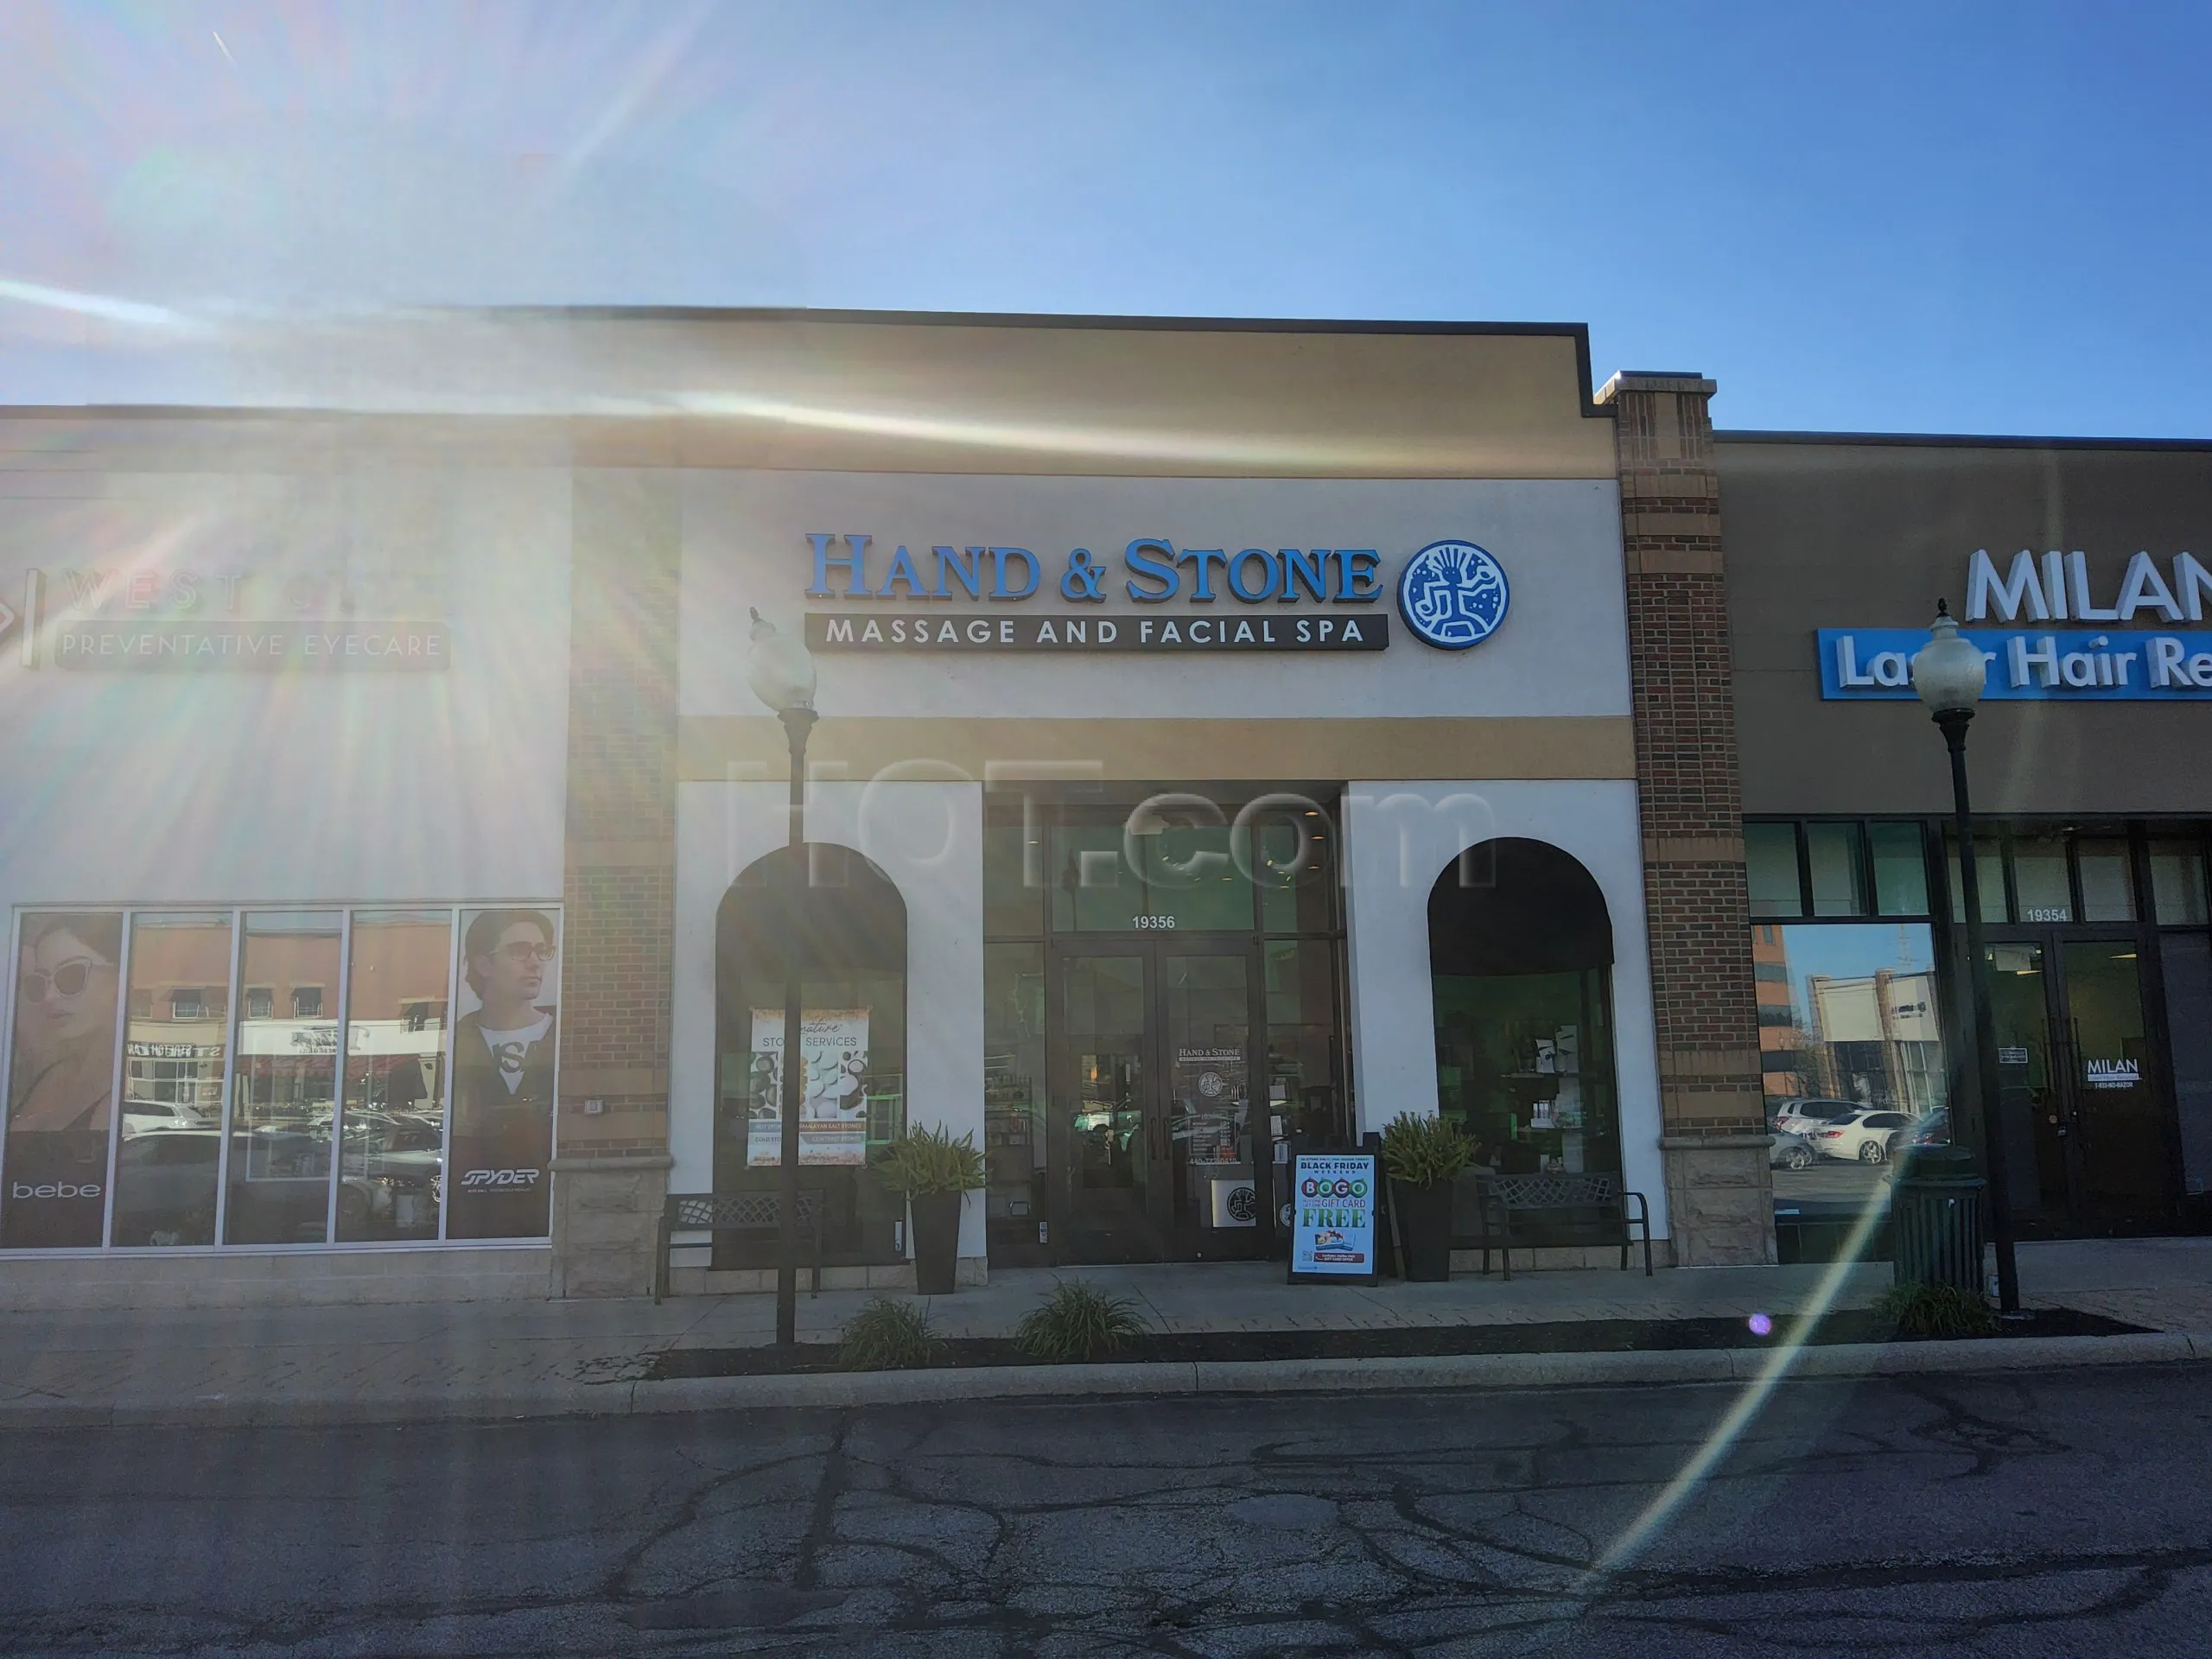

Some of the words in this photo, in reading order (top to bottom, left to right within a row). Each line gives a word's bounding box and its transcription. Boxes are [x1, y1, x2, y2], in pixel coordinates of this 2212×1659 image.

[804, 533, 1041, 602] HAND
[1060, 547, 1107, 603] &
[1124, 538, 1383, 605] STONE
[62, 567, 245, 613] WEST
[825, 618, 1015, 646] MASSAGE
[1037, 619, 1118, 645] AND
[1140, 619, 1277, 645] FACIAL
[1296, 619, 1365, 644] SPA
[62, 634, 283, 656] PREVENTATIVE
[304, 634, 442, 656] EYECARE
[1836, 635, 1998, 690] Lar
[2006, 635, 2138, 689] Hair
[1132, 915, 1176, 930] 19356
[2027, 908, 2068, 923] 19354
[762, 1037, 785, 1047] STO
[805, 1036, 857, 1047] SERVICES
[1212, 1047, 1240, 1056] STONE
[2088, 1058, 2139, 1073] MILAN
[461, 1169, 540, 1185] SPYDER
[13, 1180, 102, 1200] bebe
[1305, 1181, 1365, 1194] BOGO
[1322, 1198, 1340, 1208] GIFT
[1343, 1198, 1365, 1208] CARD
[1302, 1208, 1366, 1228] FREE
